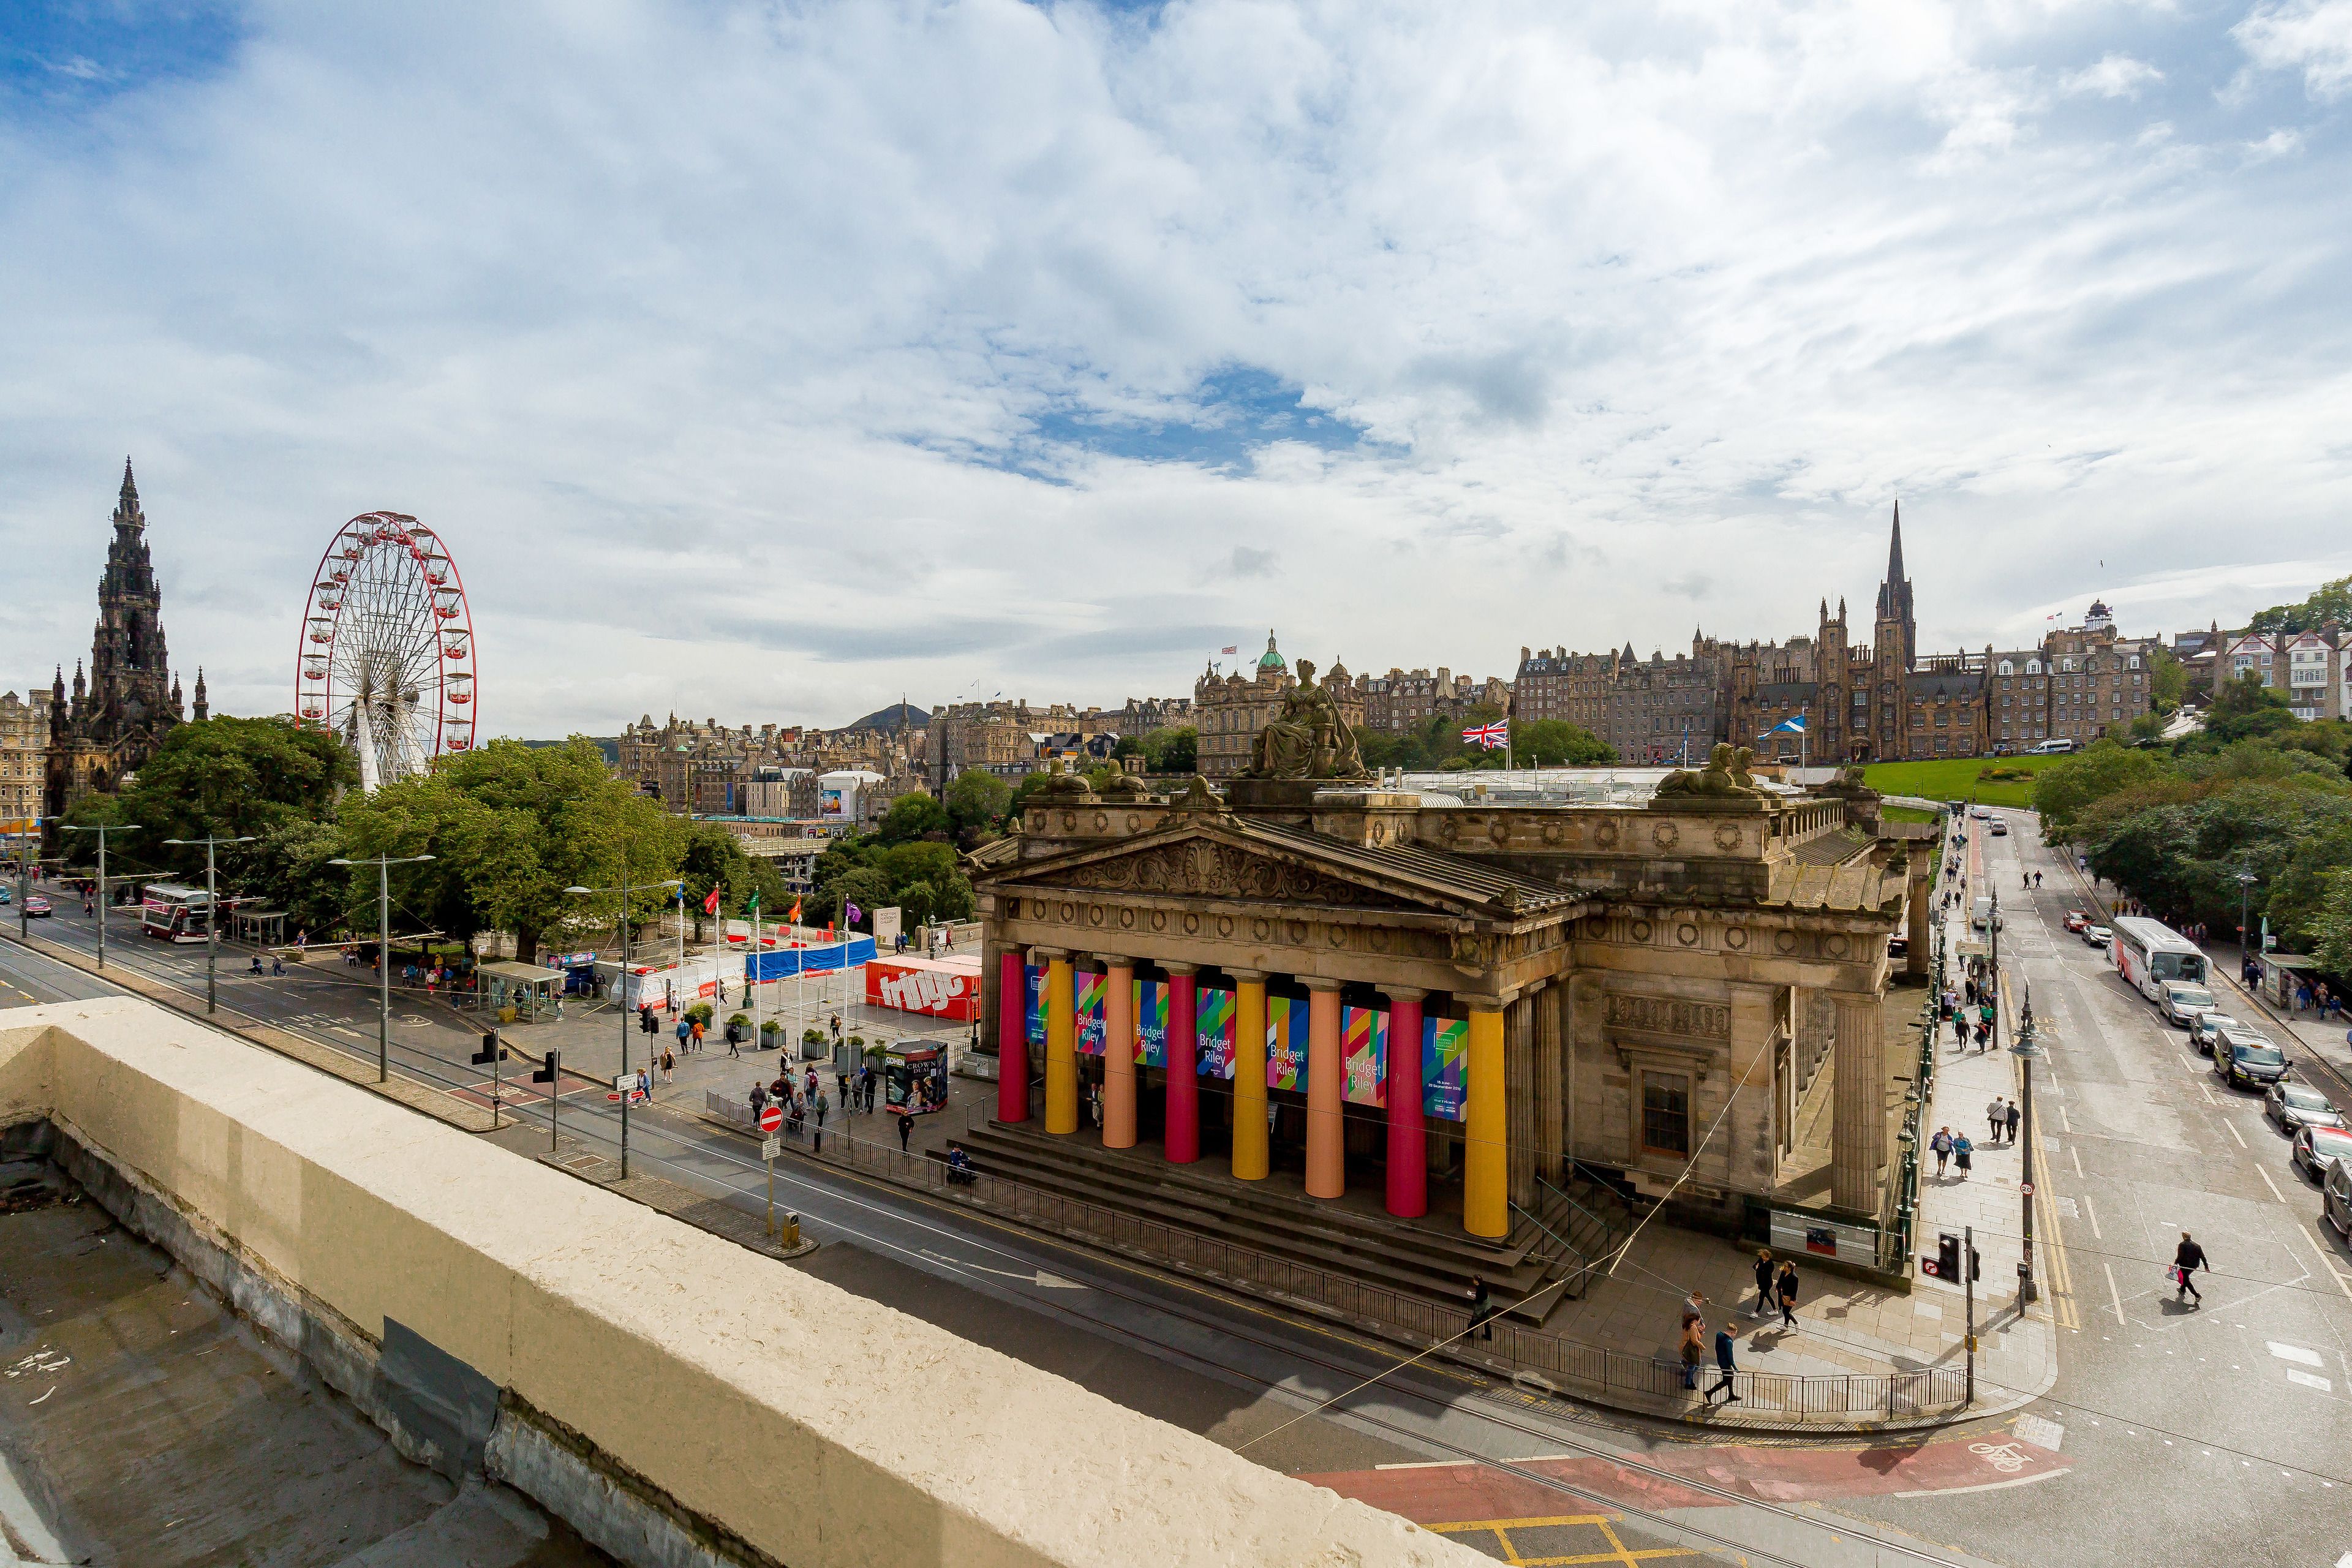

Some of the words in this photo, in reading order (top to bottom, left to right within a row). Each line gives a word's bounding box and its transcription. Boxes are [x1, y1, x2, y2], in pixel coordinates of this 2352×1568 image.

[880, 970, 964, 1011] fringe
[1078, 1014, 1104, 1030] Bridget
[1082, 1029, 1099, 1045] Riley
[1136, 1023, 1165, 1041] Bridget
[1141, 1039, 1160, 1057] Riley
[1200, 1033, 1231, 1052] Bridget
[886, 1057, 905, 1067] COHEN
[1205, 1050, 1226, 1068] Riley
[1270, 1044, 1304, 1063] Bridget
[907, 1060, 936, 1070] CROWN
[1276, 1061, 1299, 1080] Riley
[1346, 1057, 1382, 1077] Bridget
[1351, 1075, 1376, 1095] Riley
